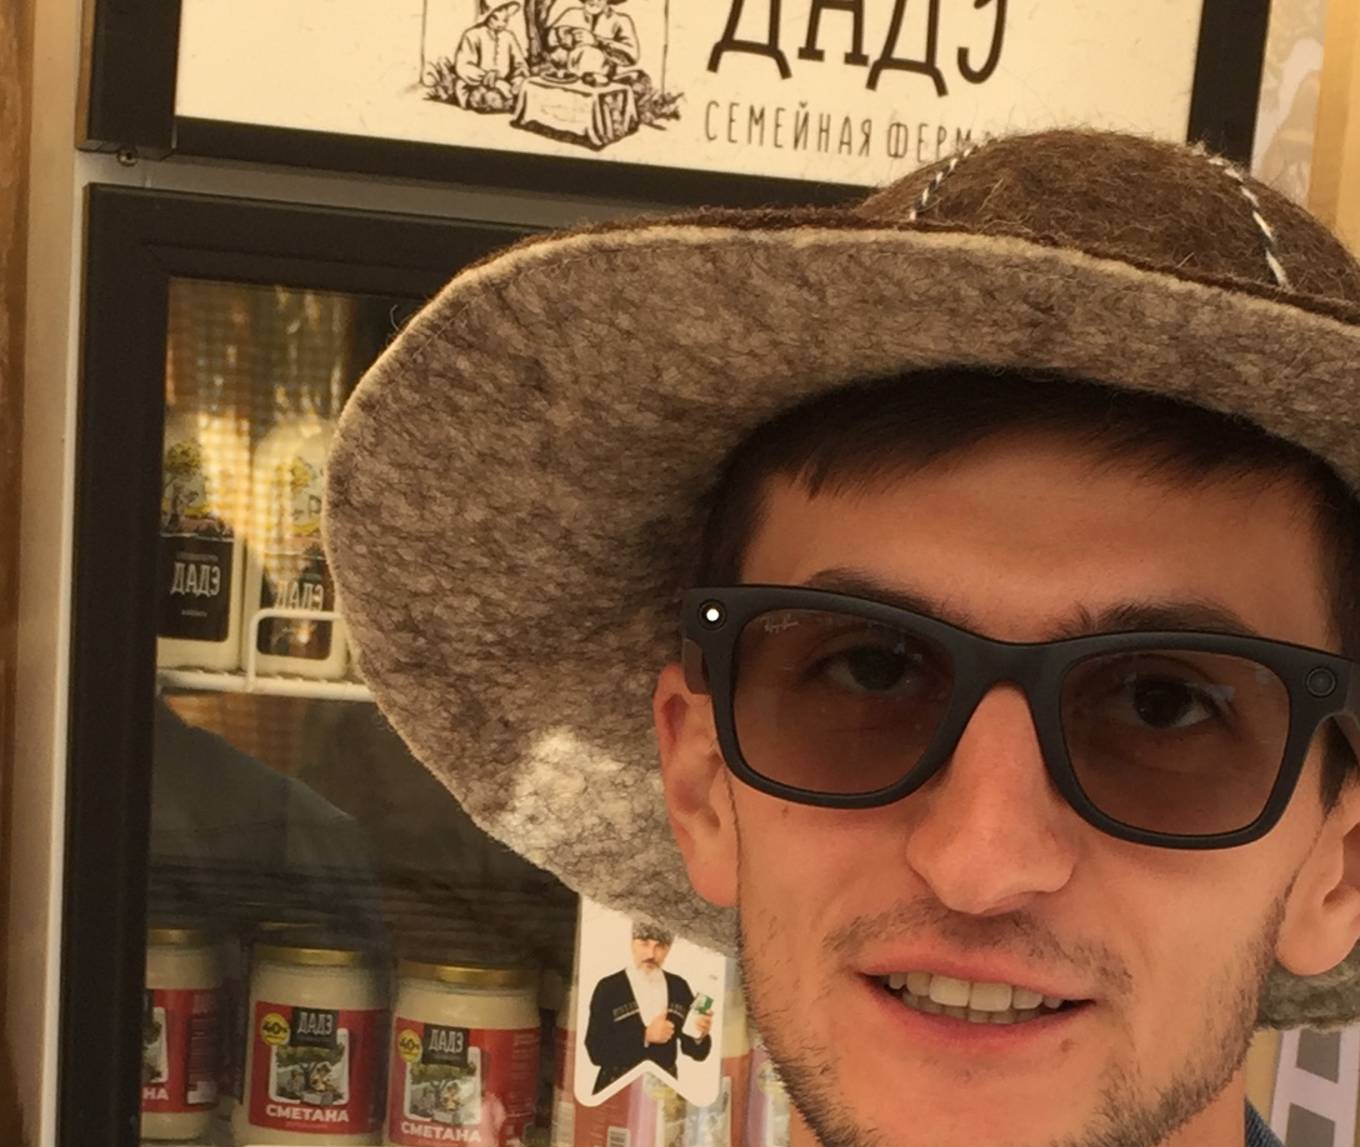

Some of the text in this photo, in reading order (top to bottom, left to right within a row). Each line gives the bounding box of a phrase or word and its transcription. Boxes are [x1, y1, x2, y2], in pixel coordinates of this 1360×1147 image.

[705, 100, 978, 163] СЕМЕЙНАЯ ФЕРМ
[169, 562, 222, 598] ДАДЭ
[296, 1011, 333, 1035] ДАДЭ
[428, 1029, 464, 1053] ДАДЭ
[265, 1103, 350, 1123] СМЕТАНА
[400, 1120, 482, 1143] СМЕТАНА
